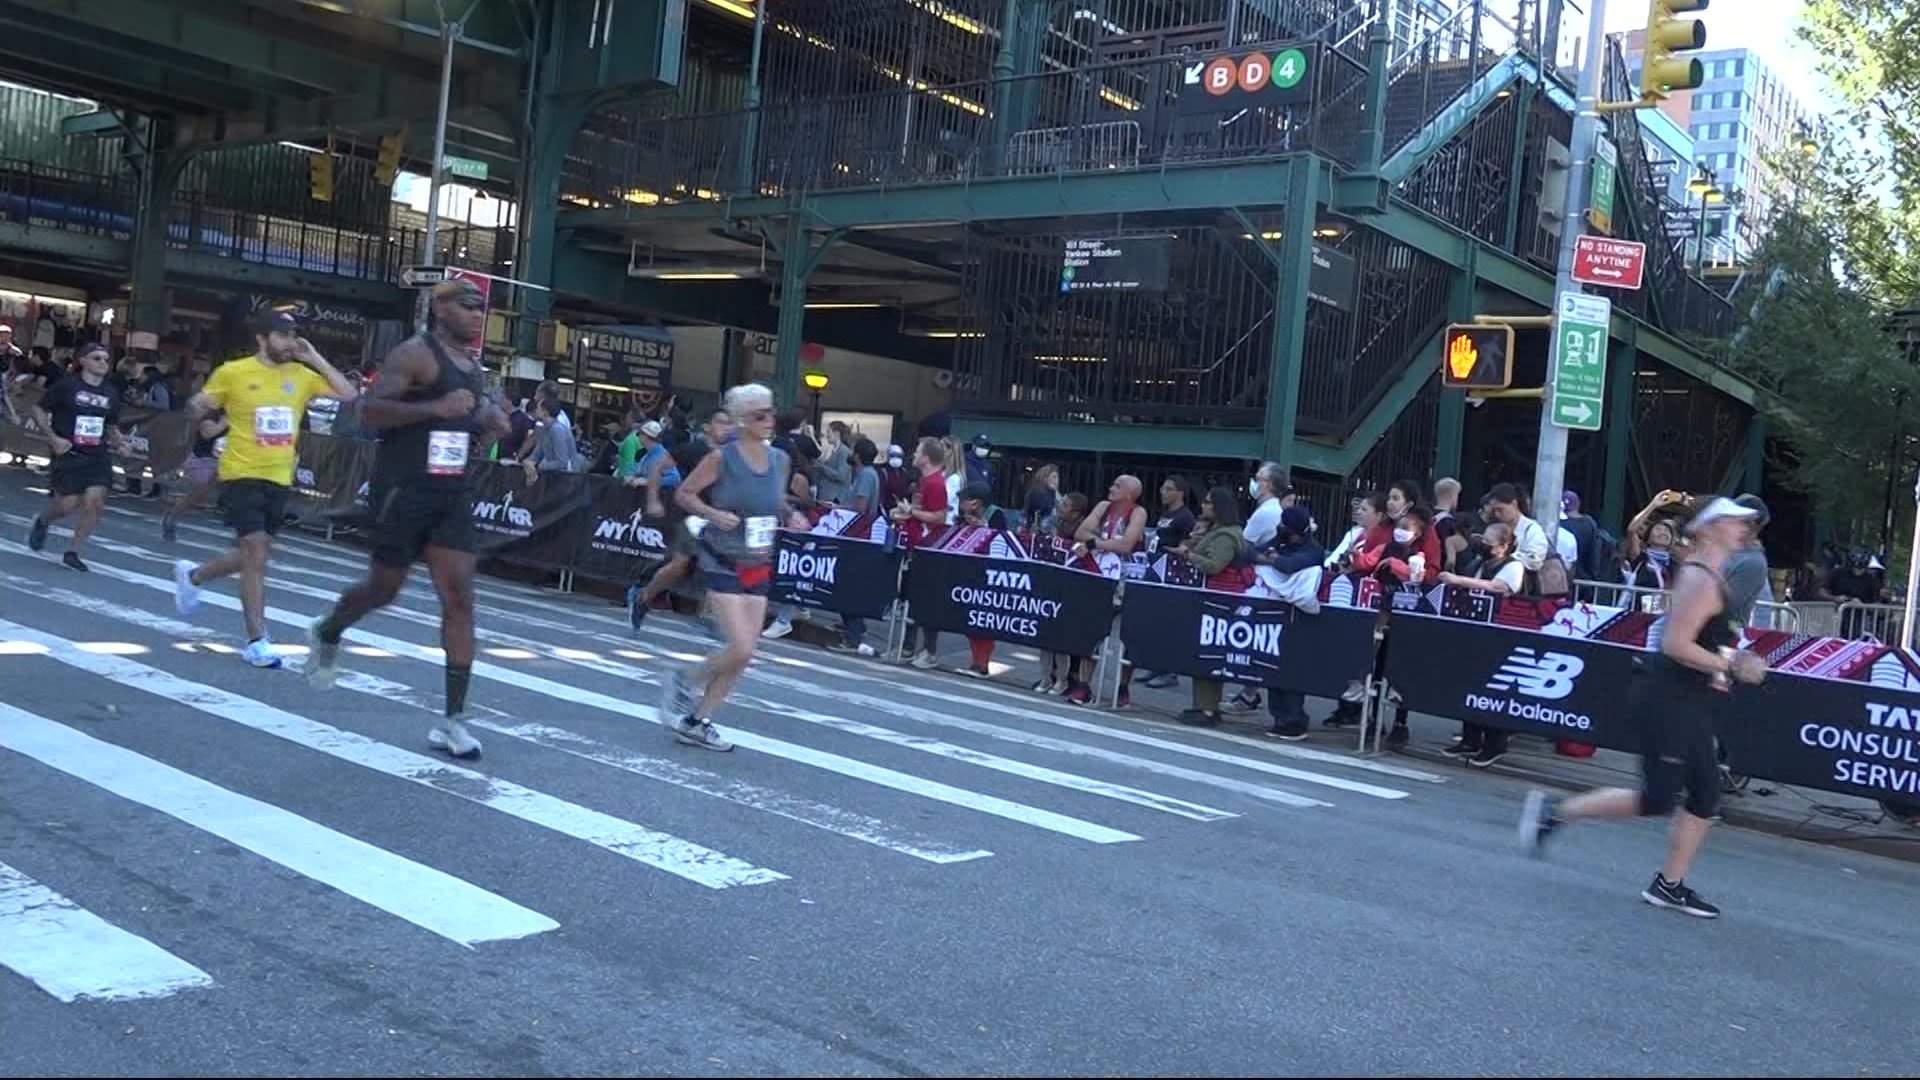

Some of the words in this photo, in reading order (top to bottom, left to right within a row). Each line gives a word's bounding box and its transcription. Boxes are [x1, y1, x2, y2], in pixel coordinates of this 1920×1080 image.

[1212, 66, 1228, 88] B
[1245, 63, 1263, 84] D
[1279, 58, 1296, 79] 4
[1063, 258, 1090, 267] Station
[1065, 250, 1091, 258] Yankee
[1092, 248, 1122, 258] Stadium
[1580, 240, 1593, 251] NO
[1597, 242, 1640, 257] STANDING
[1585, 254, 1633, 269] ANYTIME
[778, 549, 837, 584] BRONX
[985, 569, 1032, 591] TATA
[951, 586, 1062, 618] CONSULTANCY
[968, 609, 1039, 637] SERVICES
[1200, 613, 1283, 657] BRONX
[1465, 694, 1505, 713] new
[1800, 723, 1920, 763] CONSUL
[1834, 758, 1920, 793] SERVI
